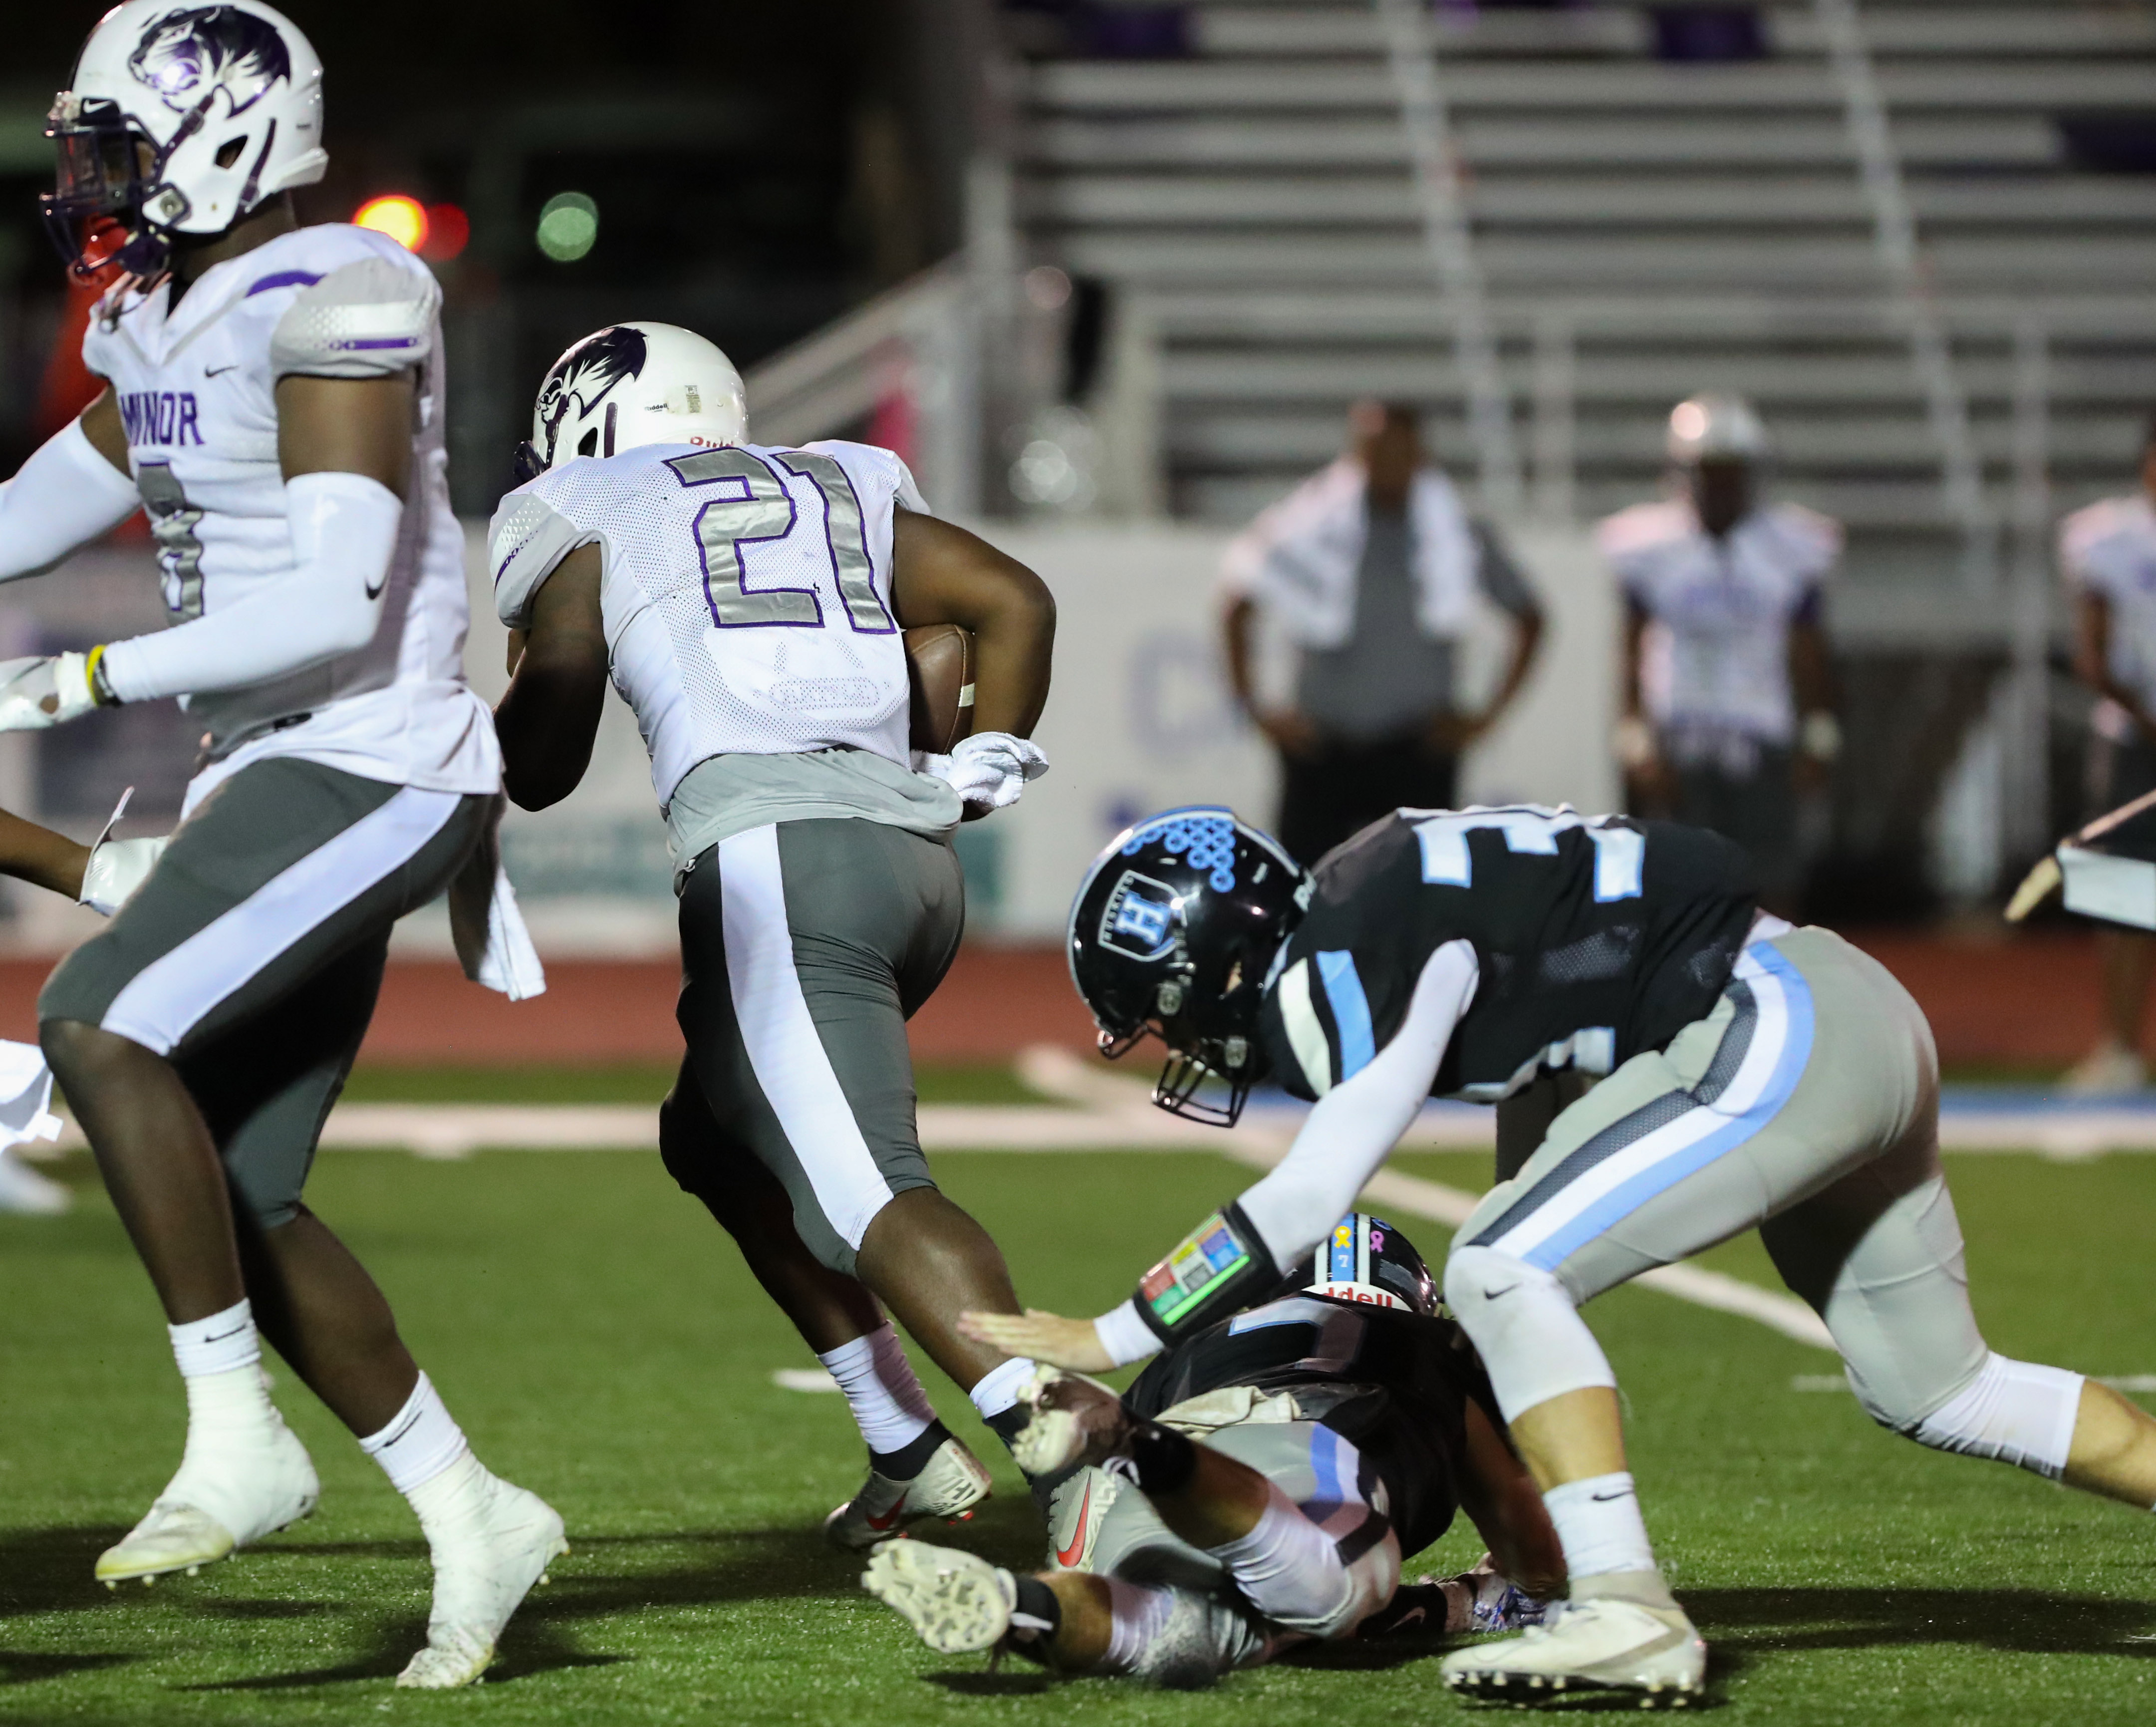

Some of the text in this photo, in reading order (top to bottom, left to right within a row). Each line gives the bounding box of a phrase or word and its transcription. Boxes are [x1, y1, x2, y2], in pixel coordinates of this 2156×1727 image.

[661, 446, 897, 634] 21
[1114, 890, 1172, 946] H
[1338, 1254, 1349, 1268] 7
[1323, 1287, 1392, 1308] ddell
